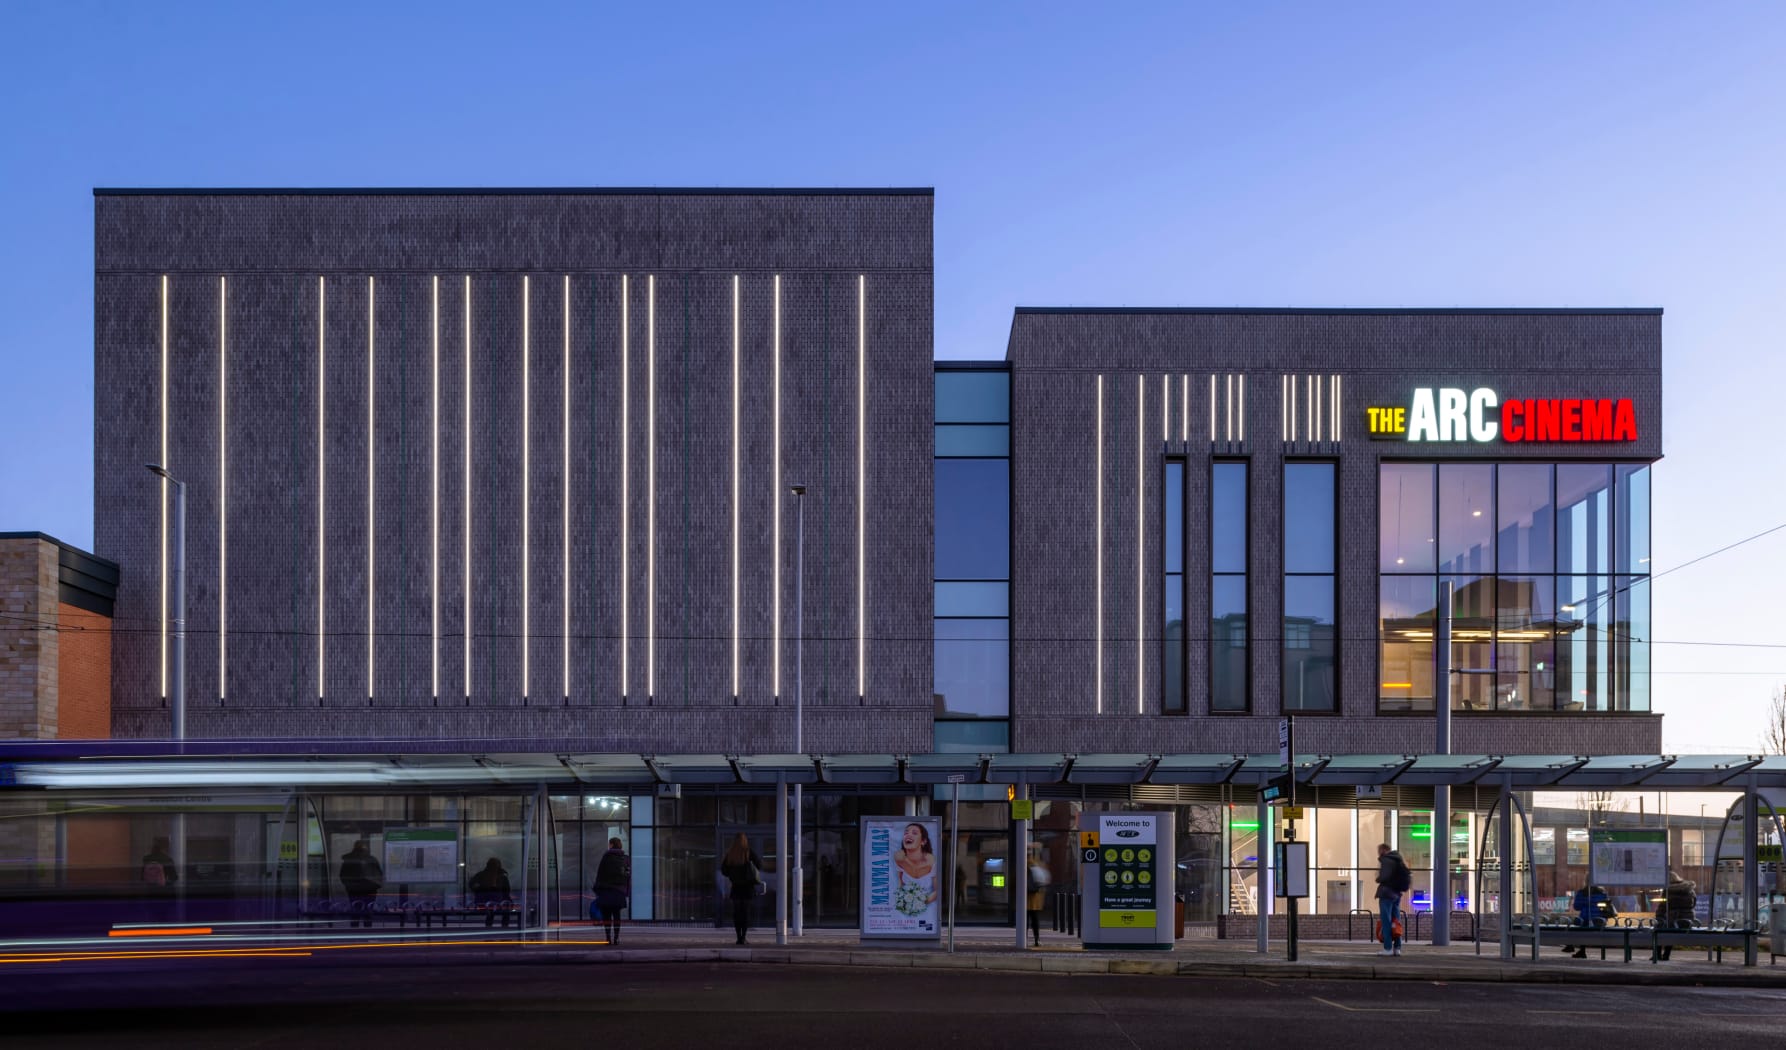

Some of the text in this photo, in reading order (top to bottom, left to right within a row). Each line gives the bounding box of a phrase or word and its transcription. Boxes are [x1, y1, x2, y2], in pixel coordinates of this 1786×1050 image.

[1367, 387, 1638, 443] THE ARC CINEMA
[664, 784, 672, 792] A
[1368, 785, 1376, 793] A
[1105, 819, 1150, 827] Welcome to
[871, 829, 889, 856] MIA!
[871, 859, 889, 905] MAMMA
